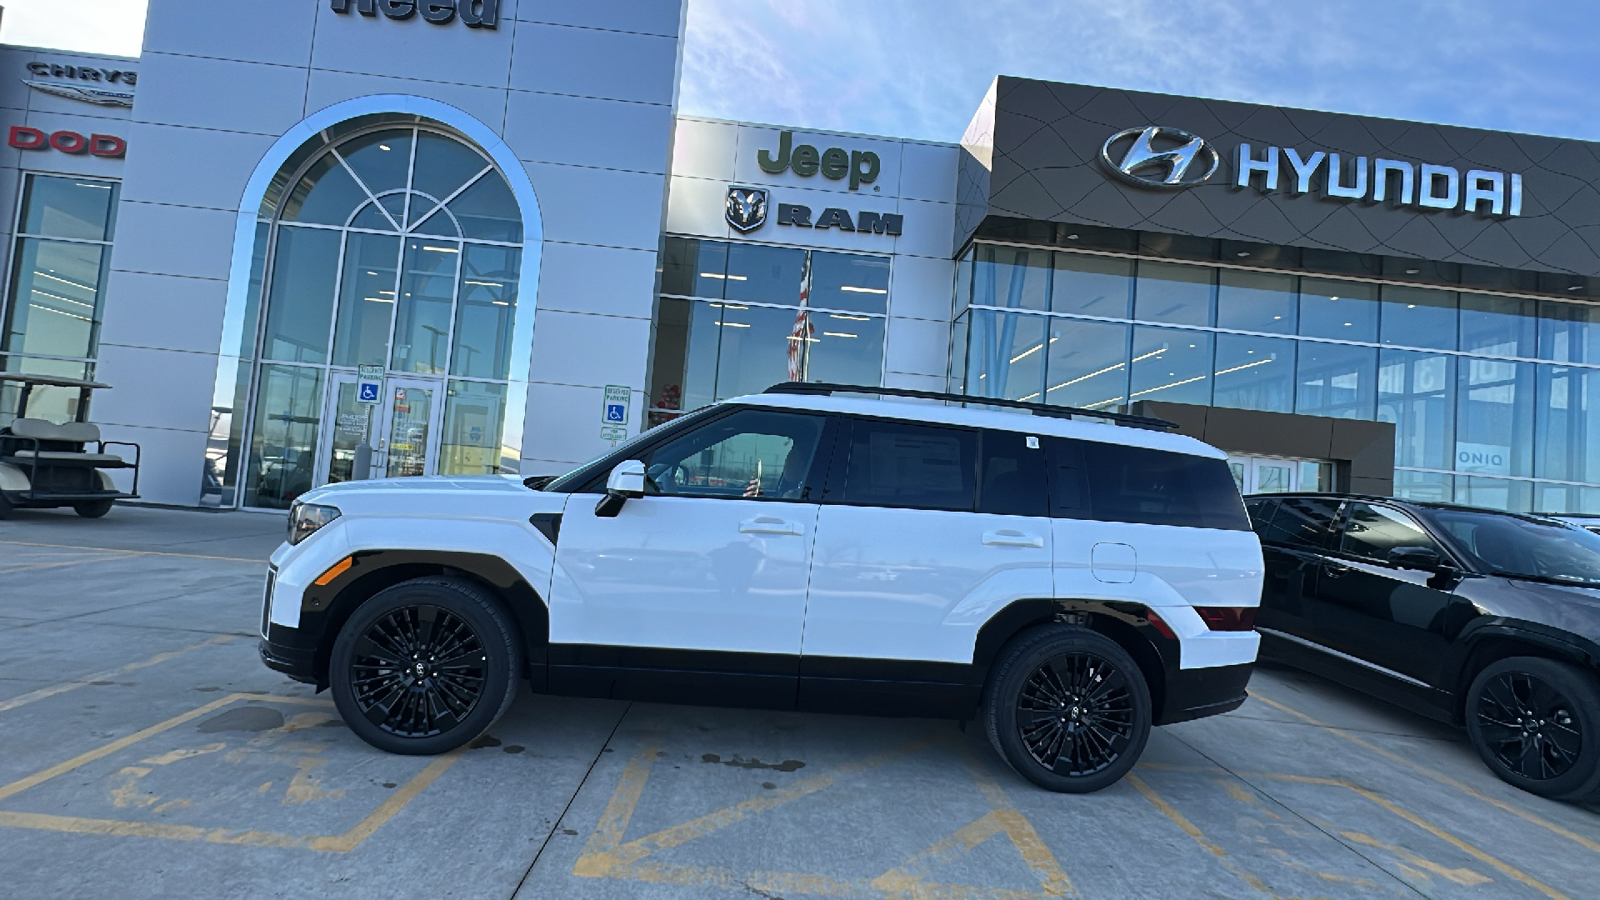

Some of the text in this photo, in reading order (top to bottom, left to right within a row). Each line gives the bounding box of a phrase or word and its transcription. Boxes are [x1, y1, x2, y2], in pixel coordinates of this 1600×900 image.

[331, 0, 498, 29] eed
[8, 125, 126, 157] DOD
[757, 130, 880, 190] Jeep
[1236, 143, 1523, 218] HYUNDAI
[777, 203, 904, 236] RAM
